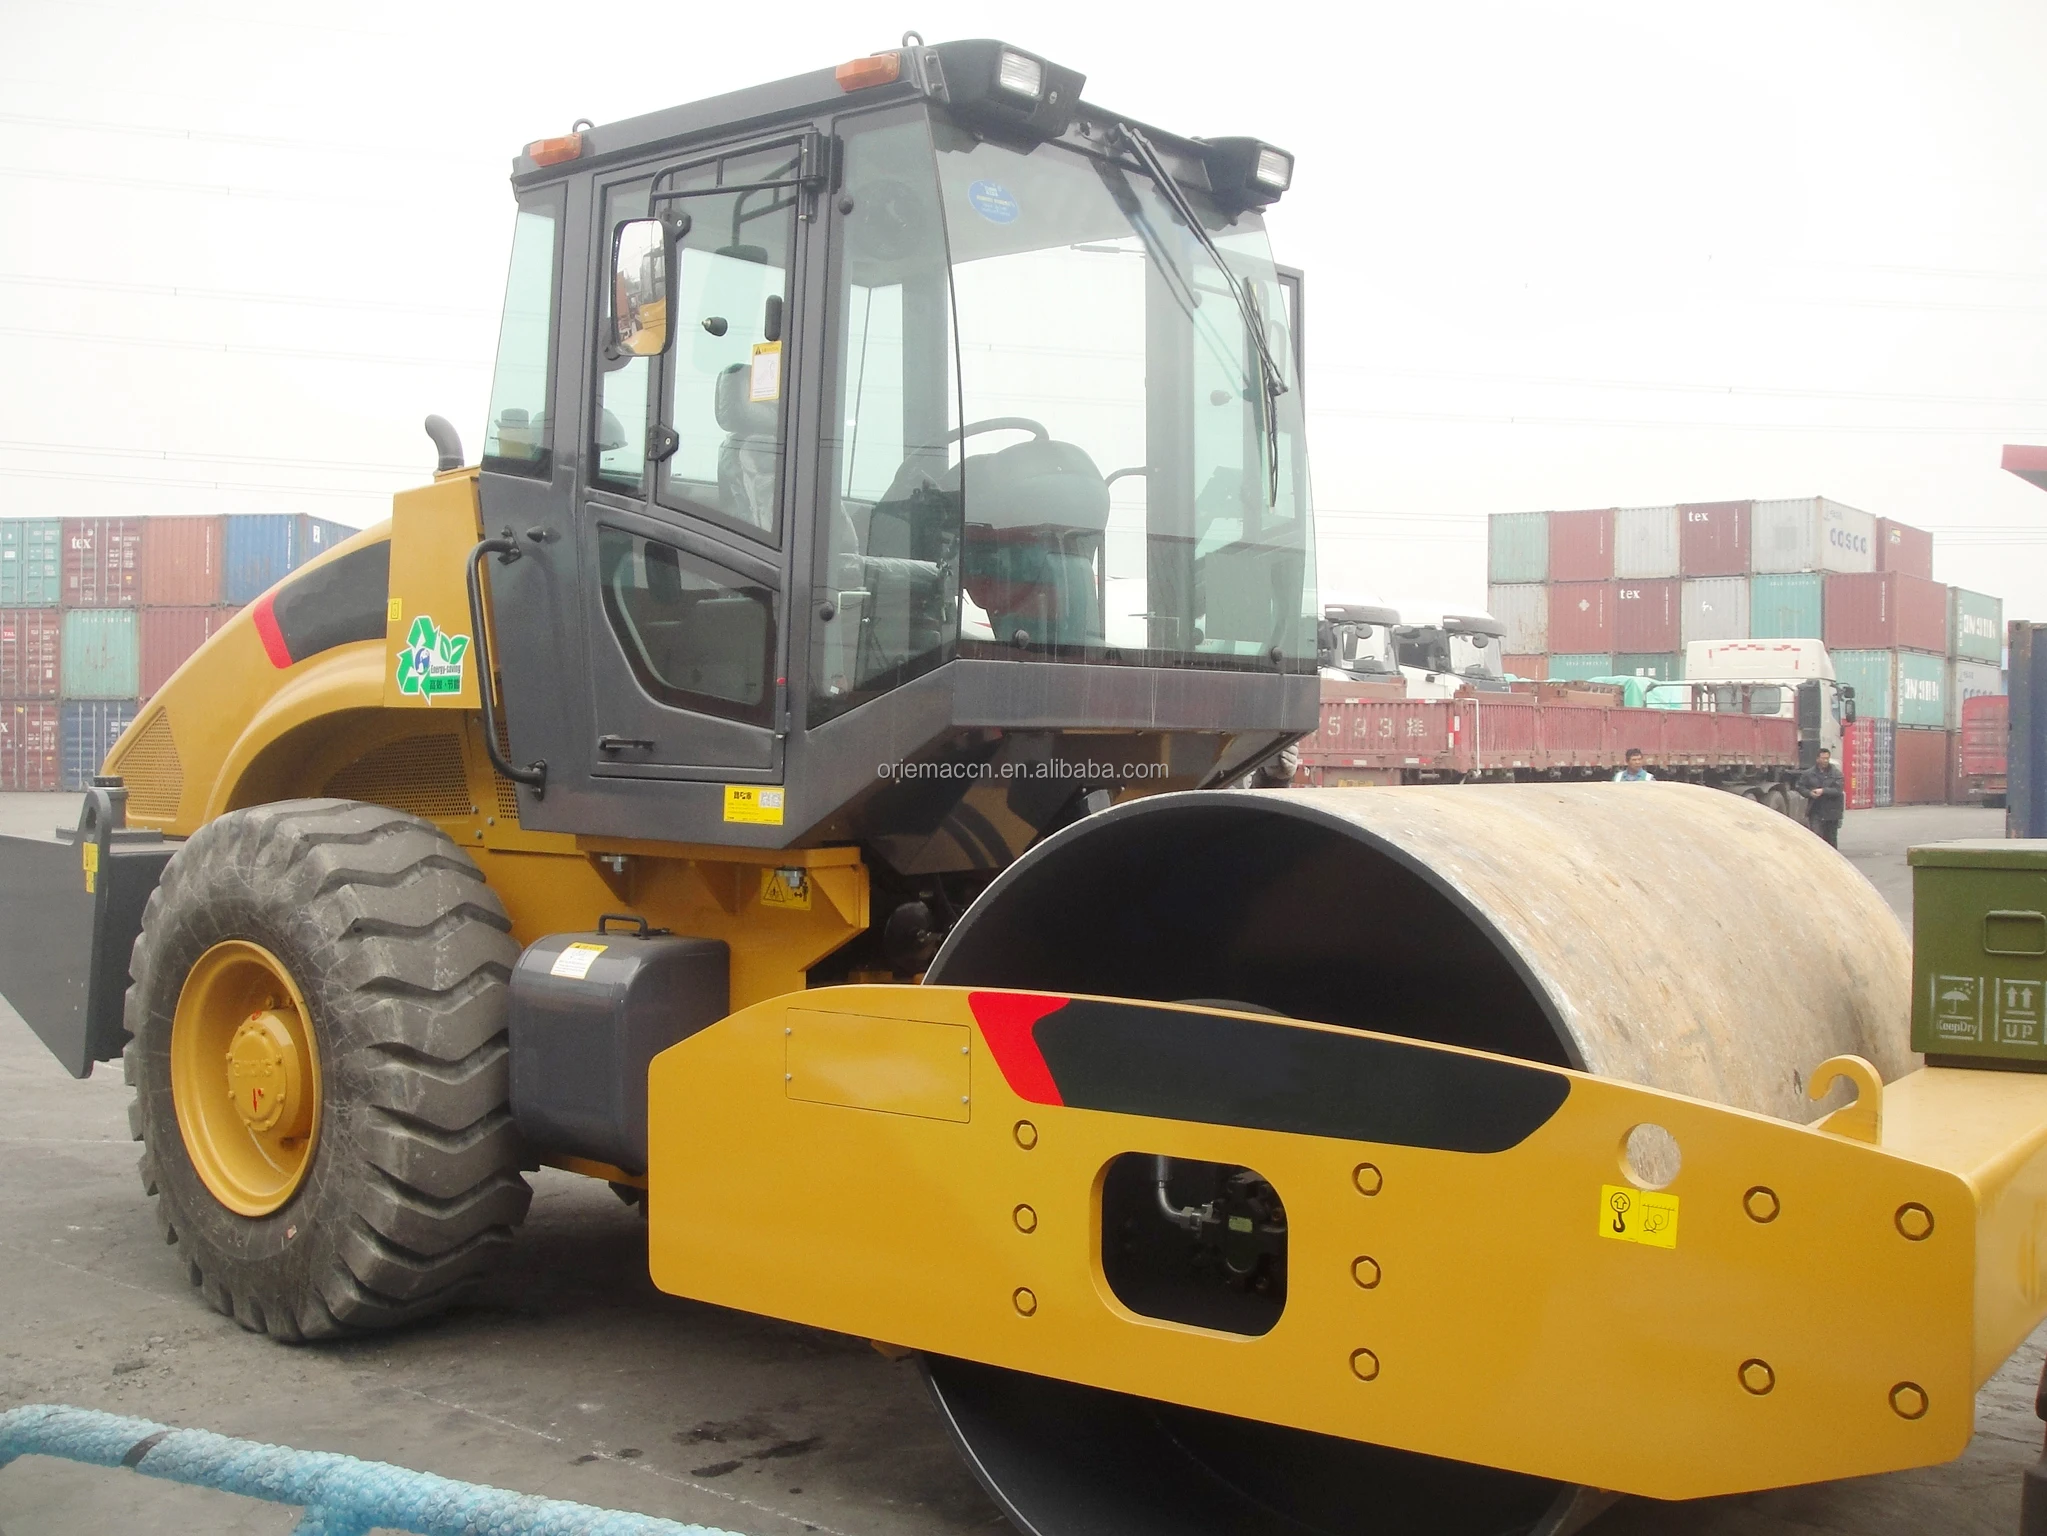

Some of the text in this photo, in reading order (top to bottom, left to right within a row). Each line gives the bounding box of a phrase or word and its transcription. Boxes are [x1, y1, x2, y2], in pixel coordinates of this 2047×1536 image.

[1688, 510, 1709, 522] tex
[1619, 588, 1640, 599] tex
[2005, 1024, 2033, 1039] UP
